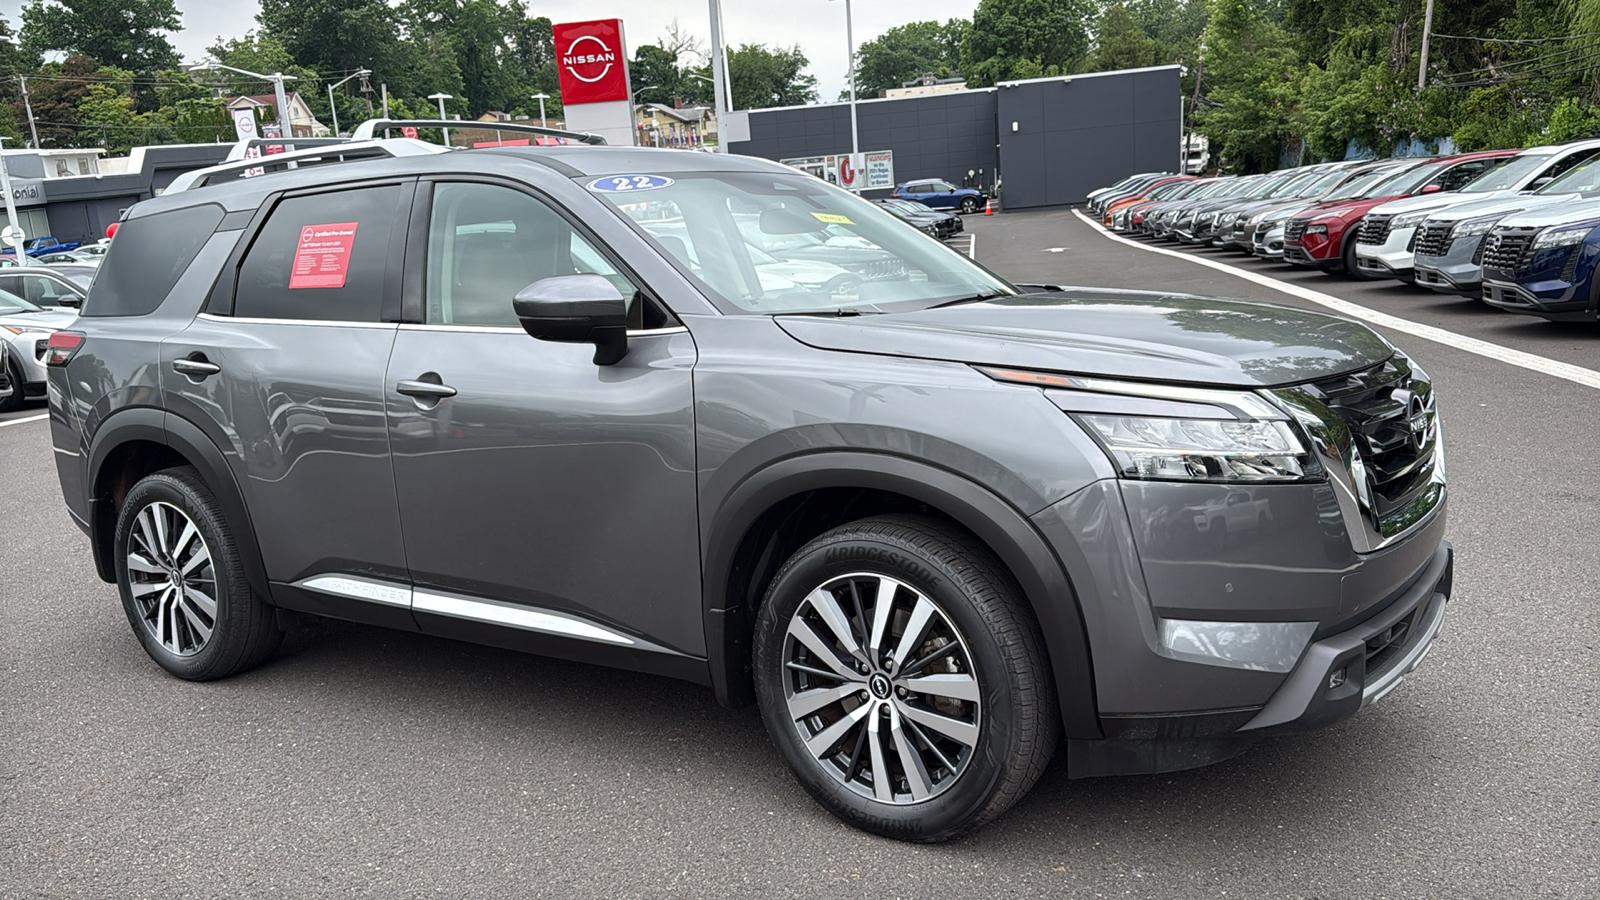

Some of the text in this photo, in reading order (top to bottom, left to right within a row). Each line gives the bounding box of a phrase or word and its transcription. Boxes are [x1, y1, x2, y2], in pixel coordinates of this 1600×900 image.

[563, 53, 615, 65] NISSAN
[612, 176, 654, 190] 22
[823, 545, 942, 591] BRIDGESTONE
[330, 580, 408, 602] PATHFINDER
